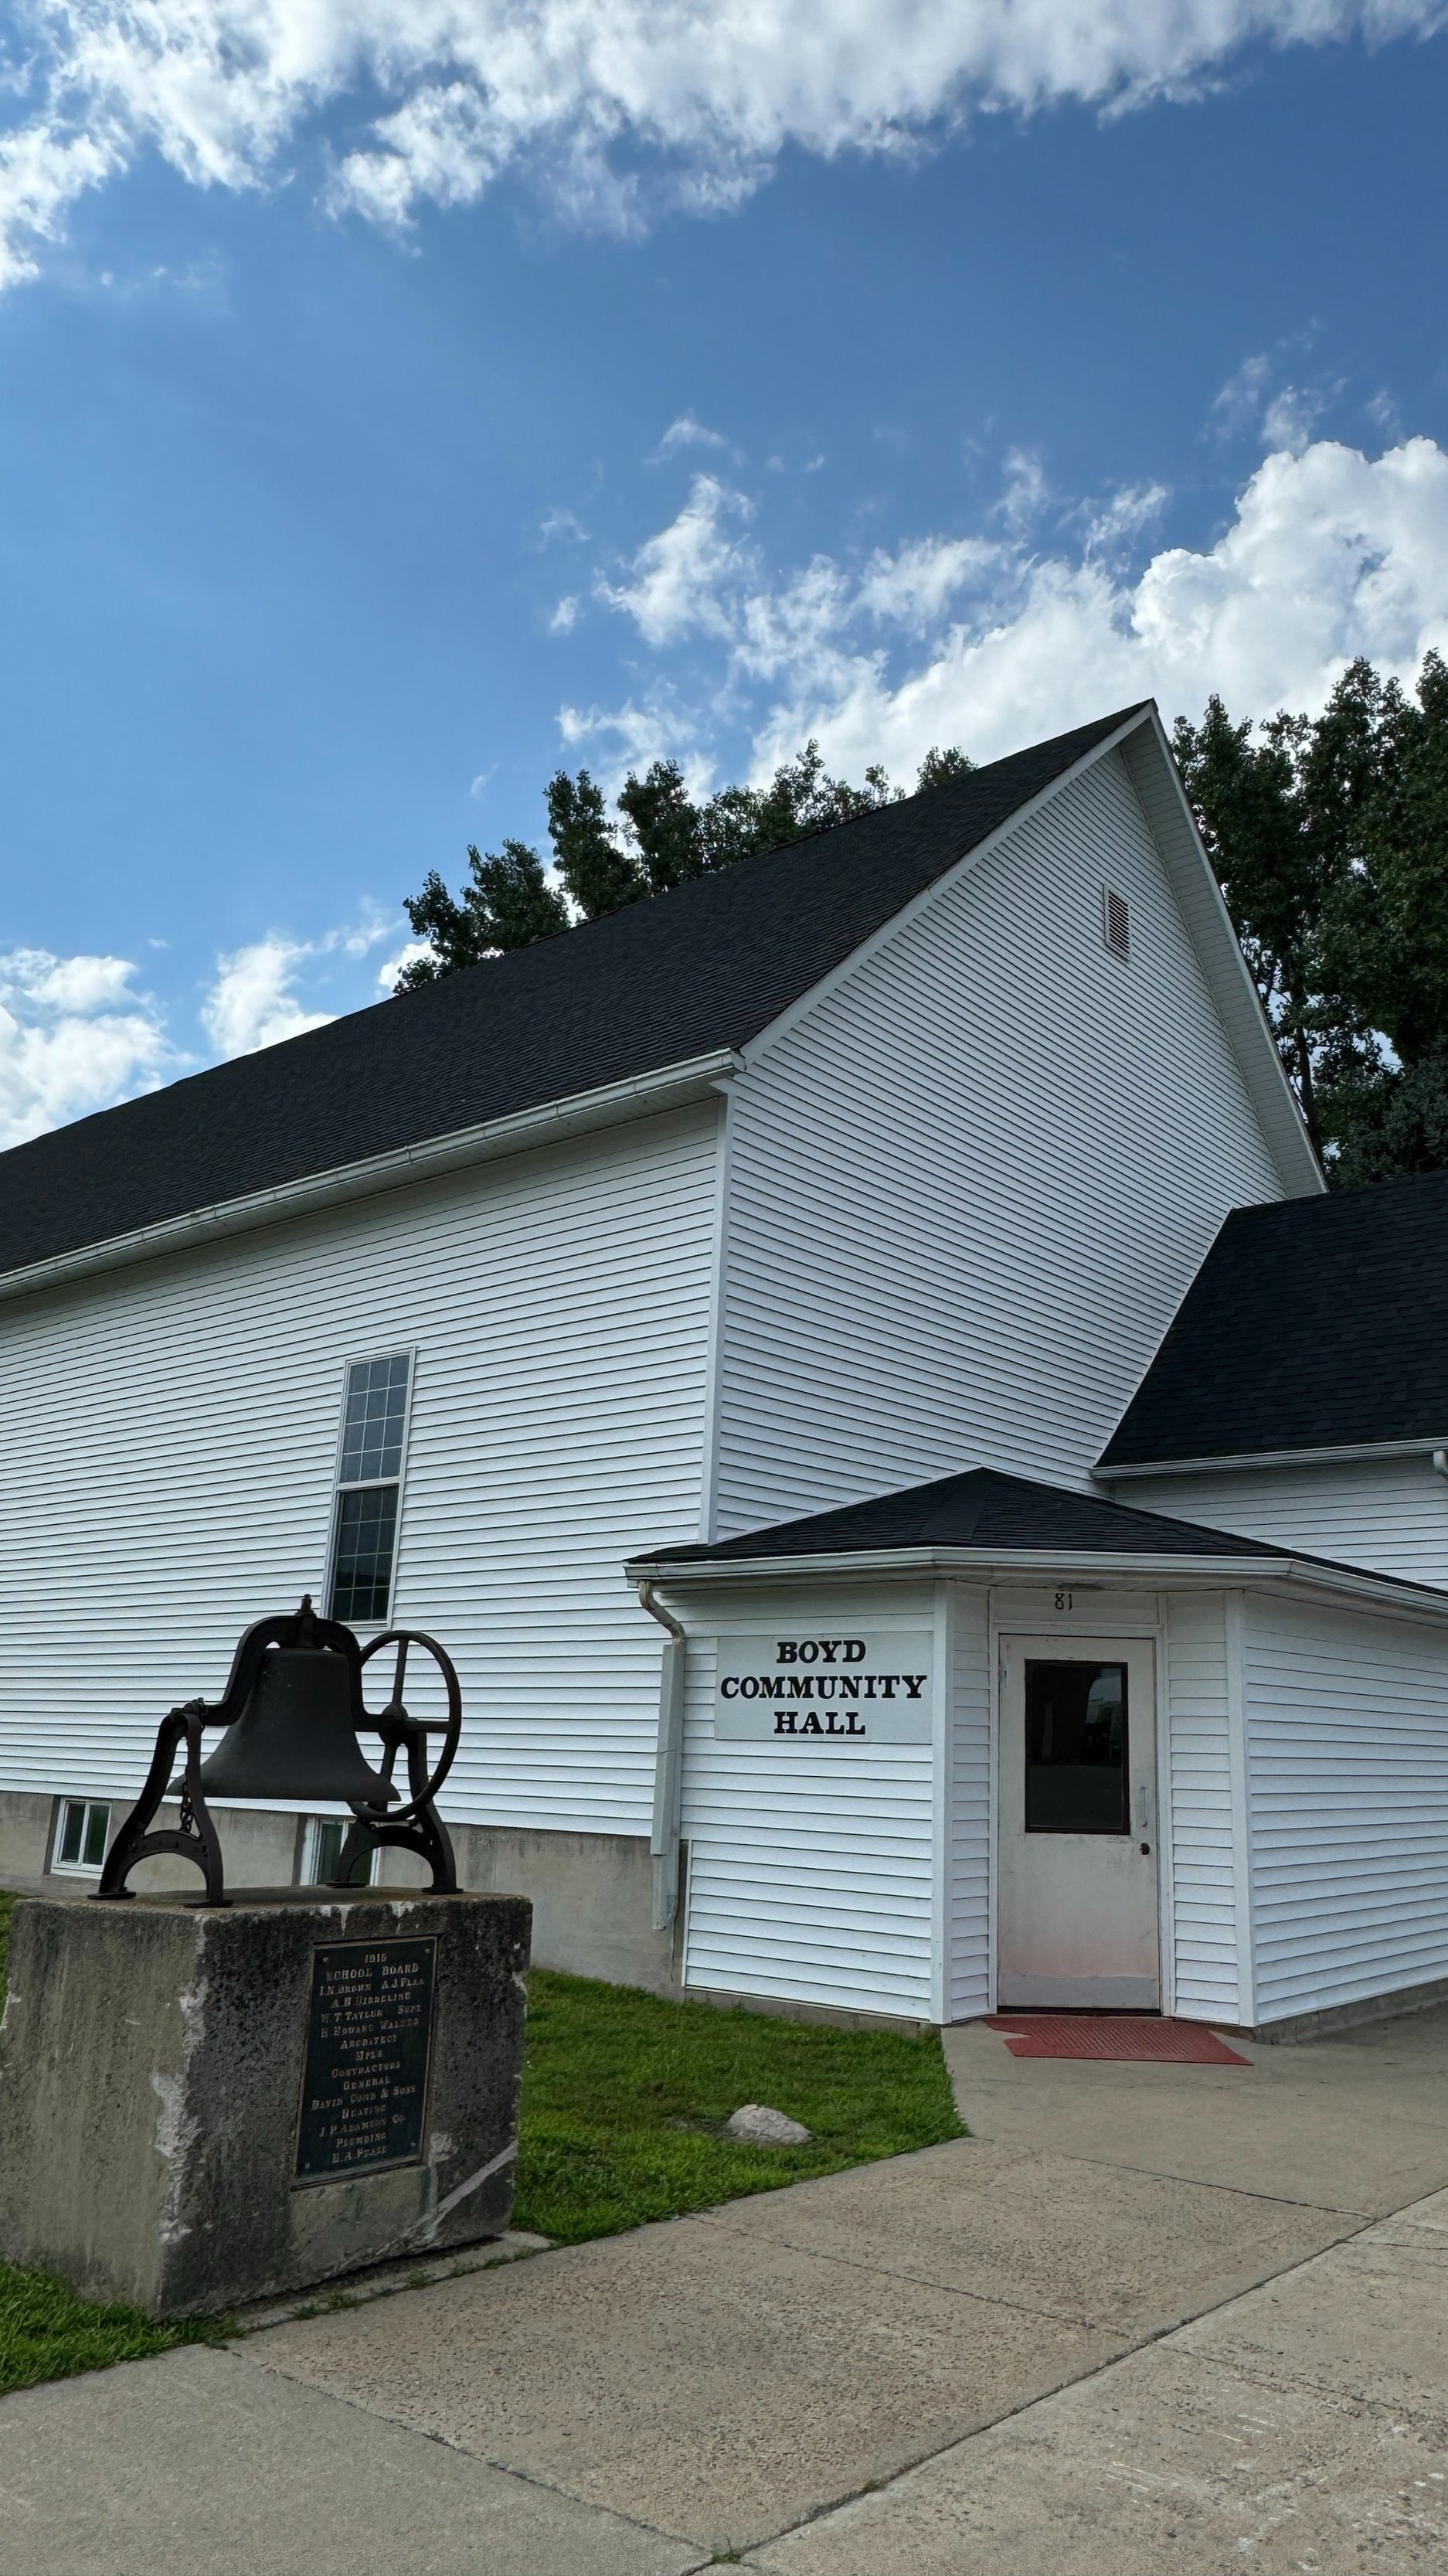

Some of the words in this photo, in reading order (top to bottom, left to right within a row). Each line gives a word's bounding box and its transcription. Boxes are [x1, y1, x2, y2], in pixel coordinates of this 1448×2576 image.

[1055, 1592, 1072, 1610] 81
[776, 1640, 866, 1663] BOYD
[720, 1676, 927, 1699] COMMUNITY
[773, 1712, 866, 1735] HALL
[326, 1968, 373, 1981] SCHOOL
[381, 1962, 419, 1976] BOARD
[340, 2034, 398, 2050] ARCHITECT
[331, 2060, 401, 2078] CONTRACTORS
[343, 2075, 390, 2090] GENERAL
[311, 2098, 343, 2110] DAVID
[380, 2088, 389, 2099] &
[336, 2132, 386, 2149] PLUMBING
